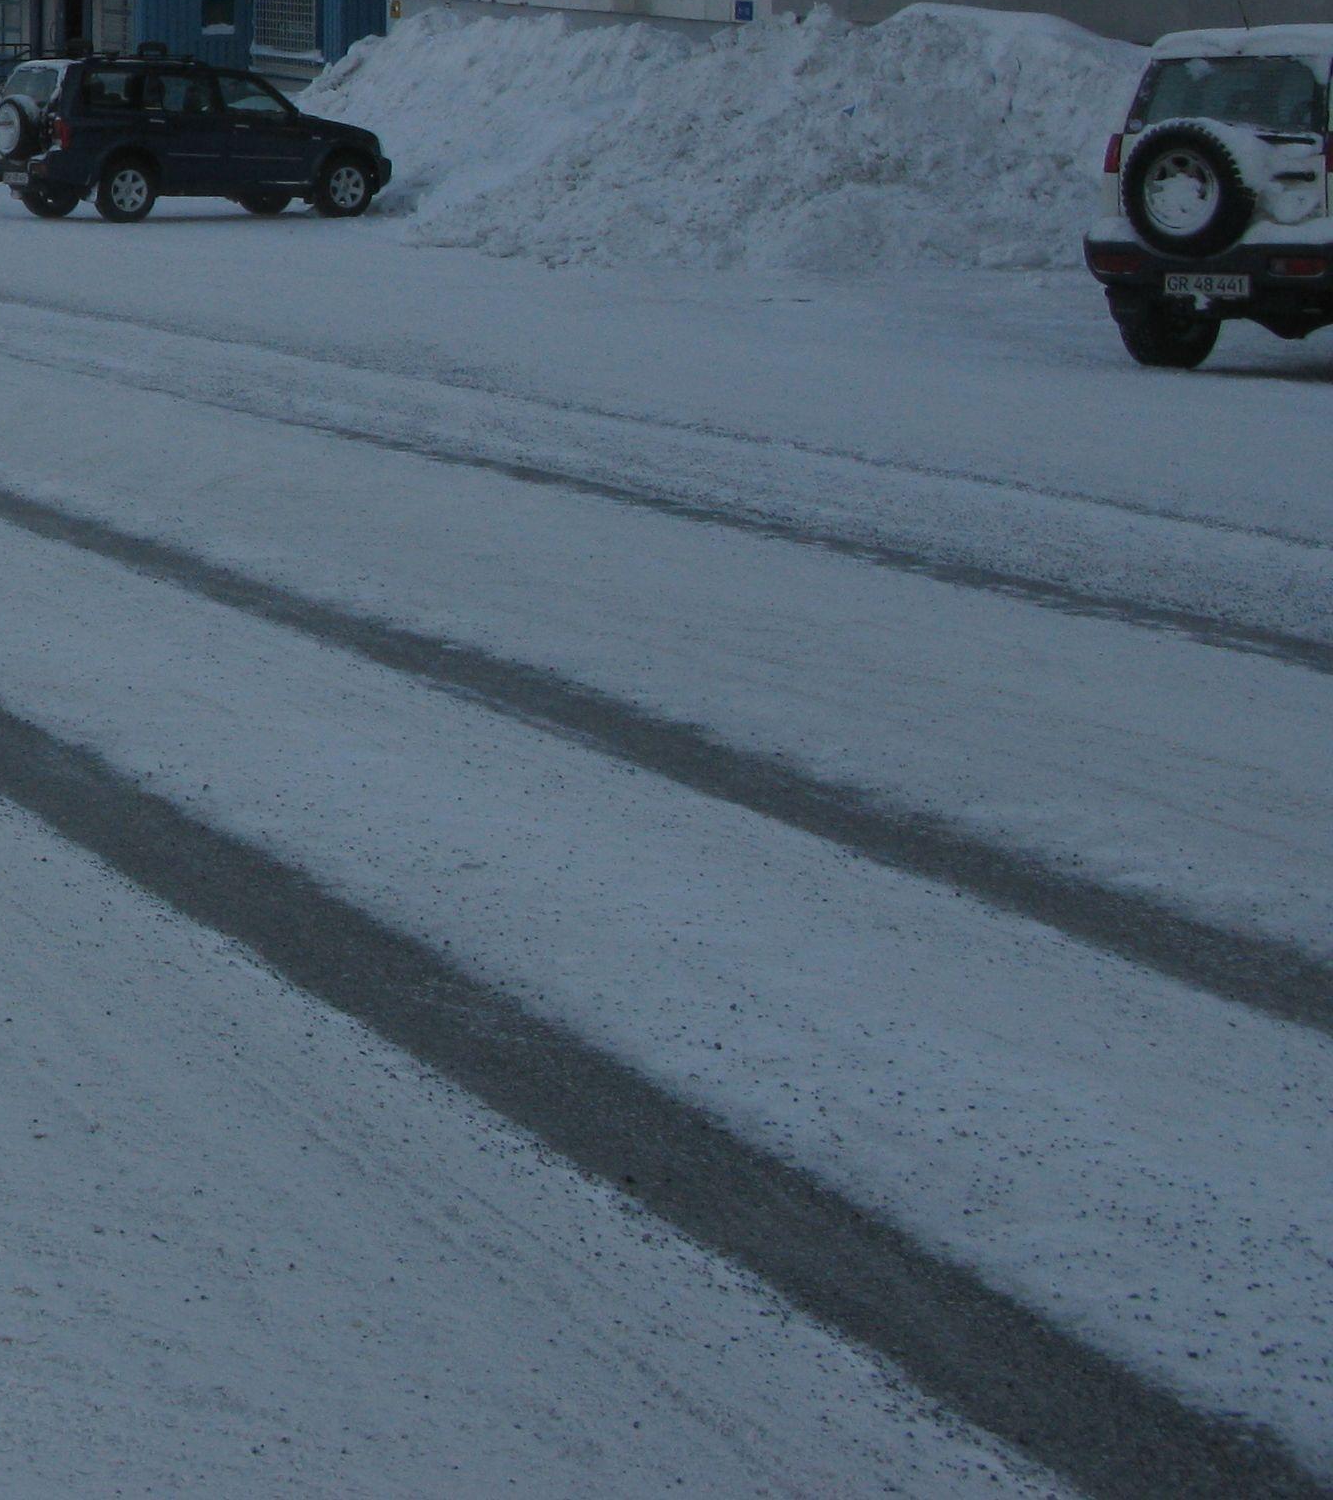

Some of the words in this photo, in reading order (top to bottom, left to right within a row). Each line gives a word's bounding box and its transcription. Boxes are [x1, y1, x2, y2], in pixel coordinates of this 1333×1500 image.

[1167, 276, 1188, 291] GR
[1194, 276, 1213, 291] 48
[1216, 277, 1242, 293] 441
